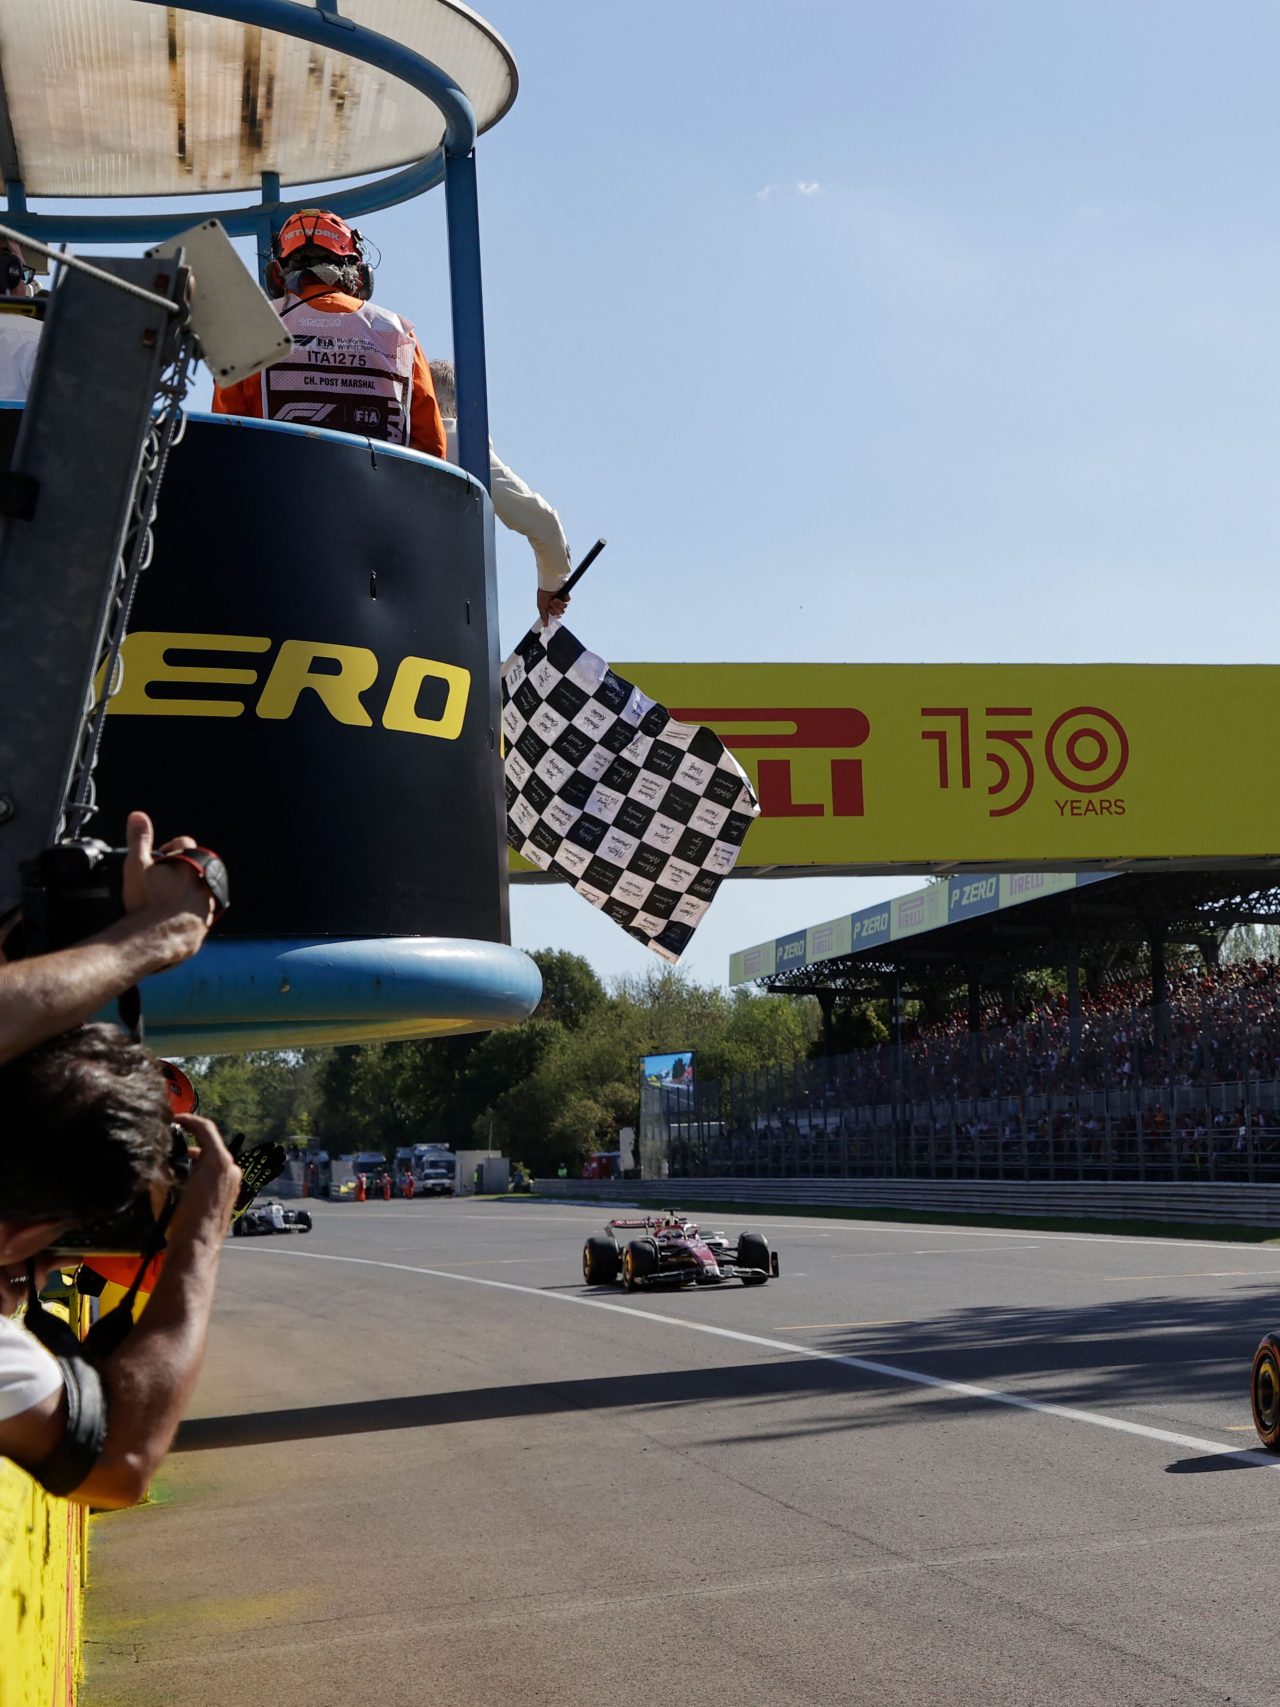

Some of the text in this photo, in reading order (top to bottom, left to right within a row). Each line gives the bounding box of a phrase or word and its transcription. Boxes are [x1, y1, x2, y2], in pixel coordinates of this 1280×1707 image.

[284, 227, 341, 241] NETWORK
[317, 337, 335, 348] FIA
[308, 350, 366, 367] ITA1275
[304, 376, 375, 390] CH. POST MARSHAL
[355, 409, 377, 423] FIA
[92, 631, 471, 740] ERO
[1055, 799, 1126, 816] YEARS
[951, 877, 997, 908] P ZERO
[853, 913, 888, 939] P ZERO
[784, 940, 804, 959] ZERO
